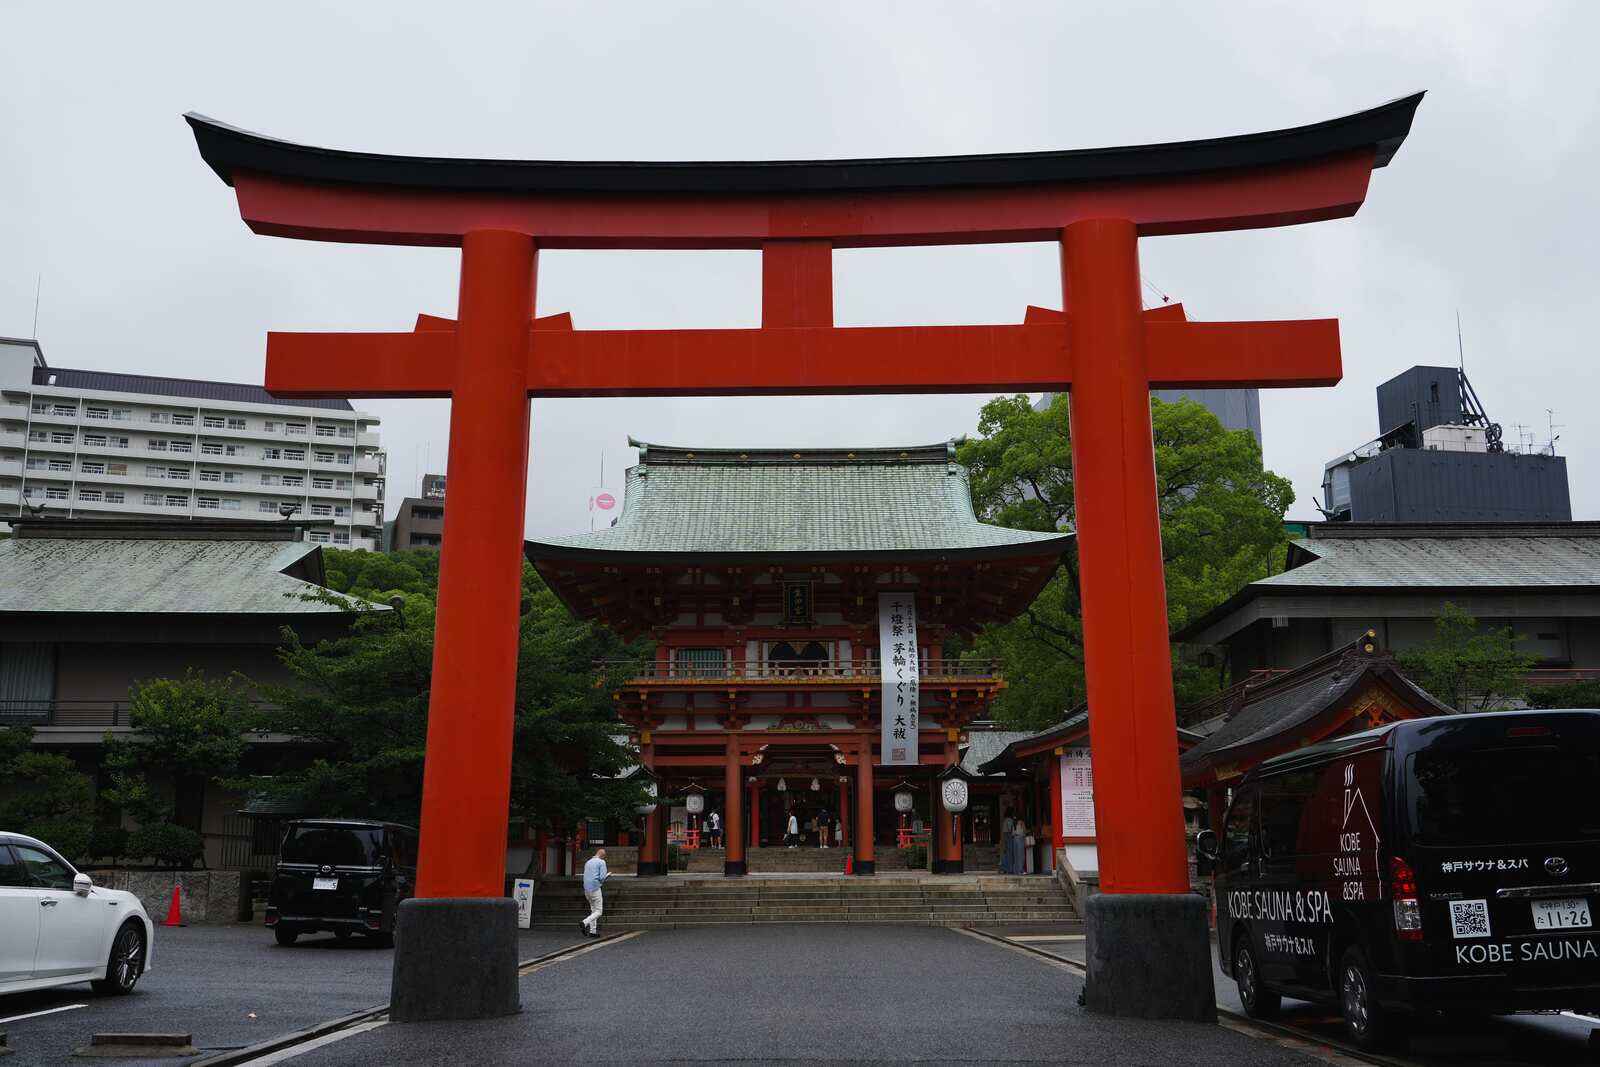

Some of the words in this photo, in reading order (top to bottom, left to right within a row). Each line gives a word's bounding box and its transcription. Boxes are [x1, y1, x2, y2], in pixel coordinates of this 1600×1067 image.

[892, 642, 906, 707] 茅輪くぐり
[1340, 832, 1361, 851] KOBE
[1333, 857, 1362, 877] SAUNA
[1342, 881, 1365, 900] &SPA
[1228, 891, 1253, 919] KOBE
[1254, 891, 1295, 921] SAUNA
[1307, 891, 1334, 923] SPA
[1456, 944, 1514, 964] KOBE
[1520, 940, 1598, 961] SAUNA
